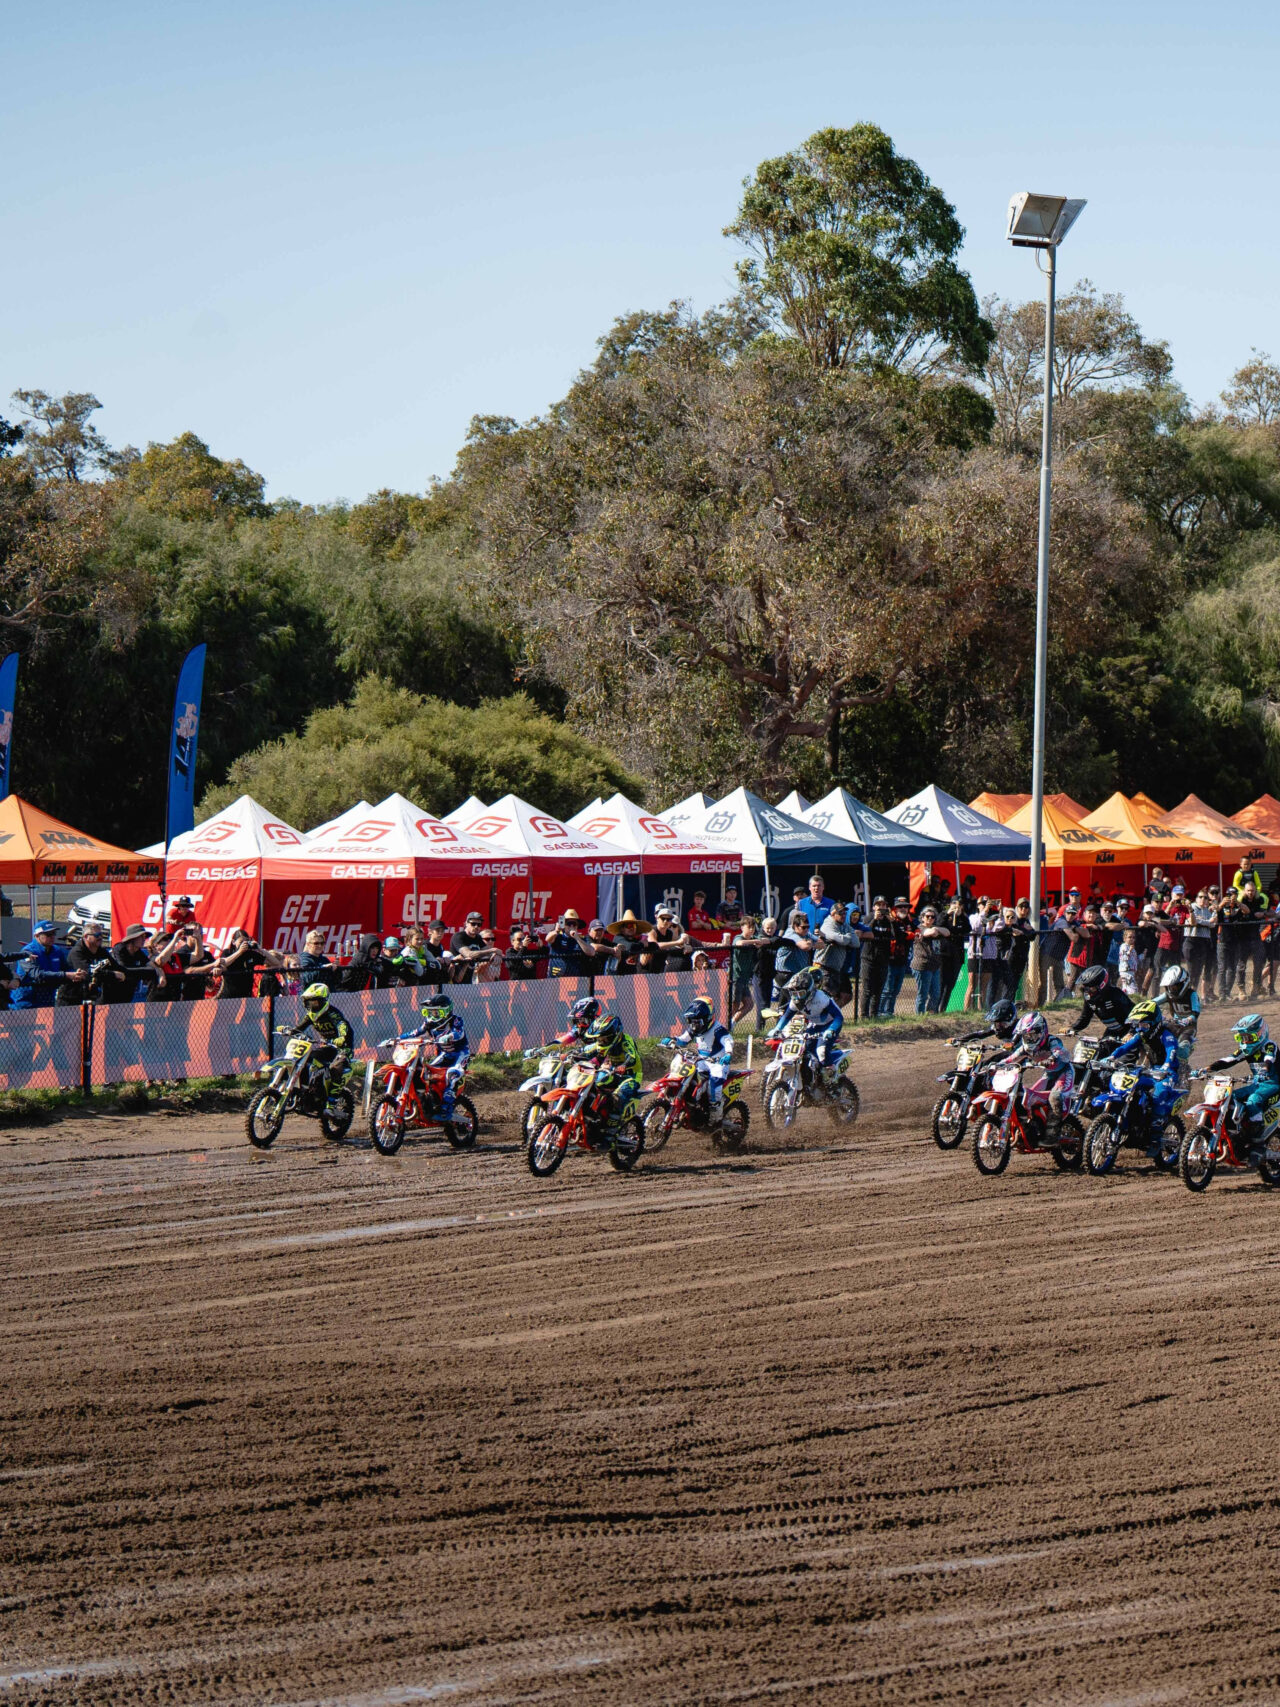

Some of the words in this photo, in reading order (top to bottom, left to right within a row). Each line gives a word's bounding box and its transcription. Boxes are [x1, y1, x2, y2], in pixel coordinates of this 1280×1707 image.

[1059, 829, 1101, 844] KTM
[1141, 825, 1180, 838] KTM
[39, 830, 96, 847] KTM
[1096, 851, 1115, 864] KTM
[1175, 848, 1193, 861] KTM
[43, 862, 66, 876] KTM
[75, 862, 98, 876] KTM
[106, 862, 129, 875] KTM
[137, 862, 159, 875] KTM
[186, 866, 258, 880] GASGAS
[331, 865, 409, 878] GASGAS
[472, 864, 528, 876] GASGAS
[584, 861, 640, 875] GASGAS
[690, 861, 740, 872] GASGAS
[280, 894, 330, 923] GET
[402, 894, 447, 922] GET
[511, 891, 552, 919] GET
[273, 926, 309, 953] ON
[784, 1044, 799, 1054] 60
[728, 1084, 741, 1096] 56
